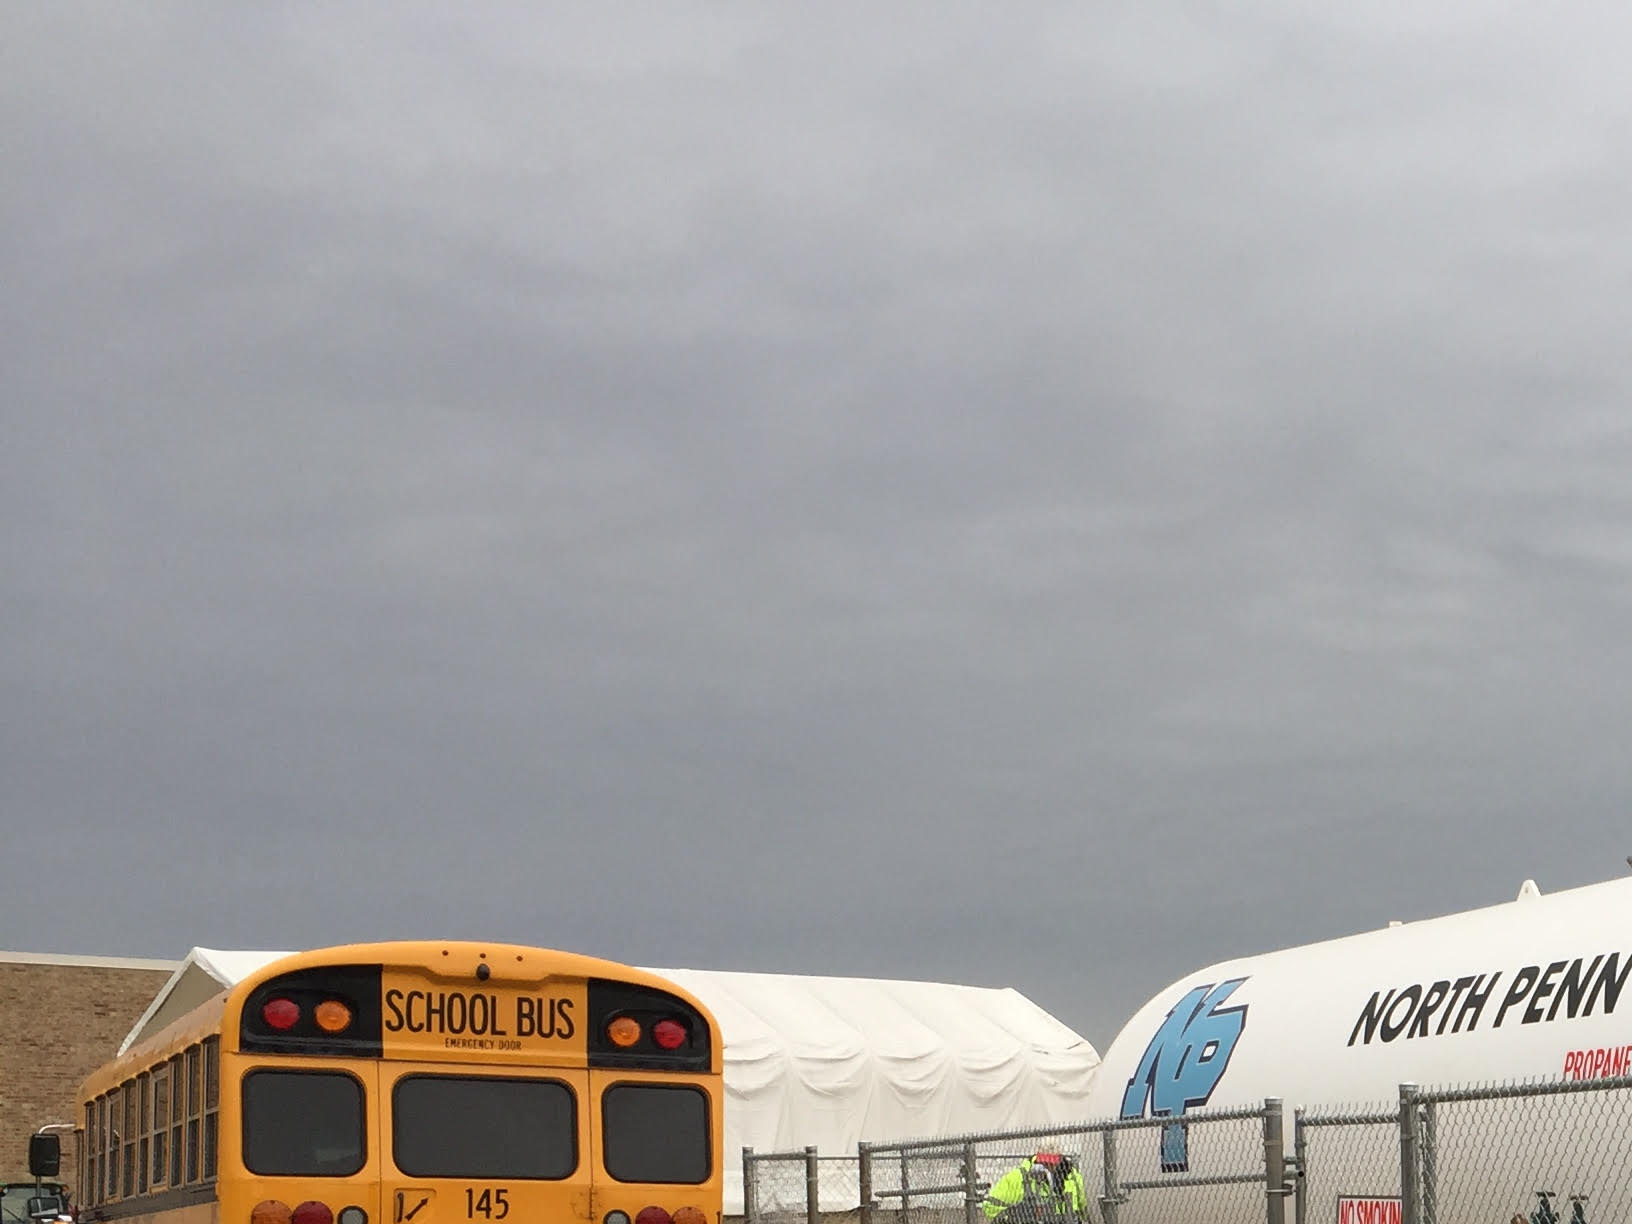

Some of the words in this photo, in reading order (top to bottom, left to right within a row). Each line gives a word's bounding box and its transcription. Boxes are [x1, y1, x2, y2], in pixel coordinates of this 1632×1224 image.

[385, 988, 507, 1036] SCHOOL
[516, 996, 575, 1040] BUS
[1347, 970, 1503, 1047] NORTH
[445, 1037, 494, 1050] EMERGENCY
[498, 1040, 522, 1051] DOOR
[465, 1187, 510, 1220] 145
